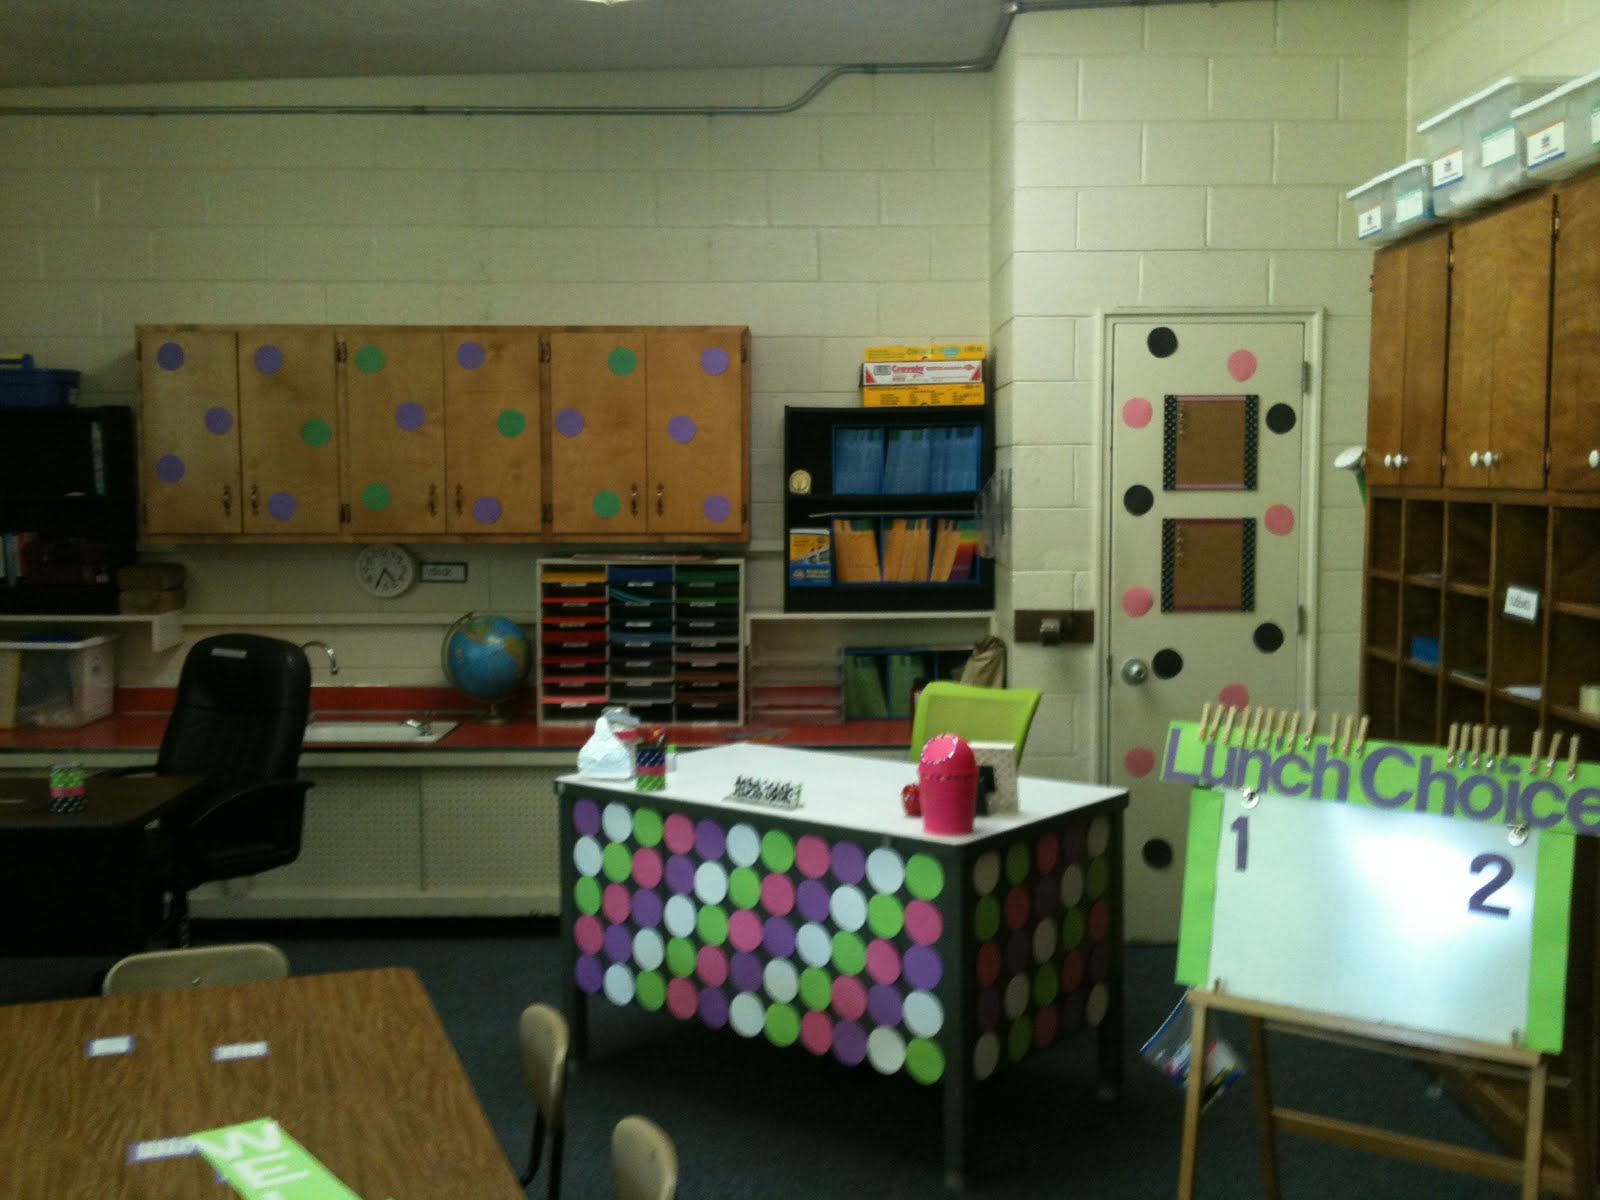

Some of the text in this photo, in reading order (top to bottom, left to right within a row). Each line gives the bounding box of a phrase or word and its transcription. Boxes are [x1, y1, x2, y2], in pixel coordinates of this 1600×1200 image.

[1163, 728, 1600, 836] Lunch Choice
[1230, 816, 1249, 871] 1
[1468, 853, 1514, 918] 2
